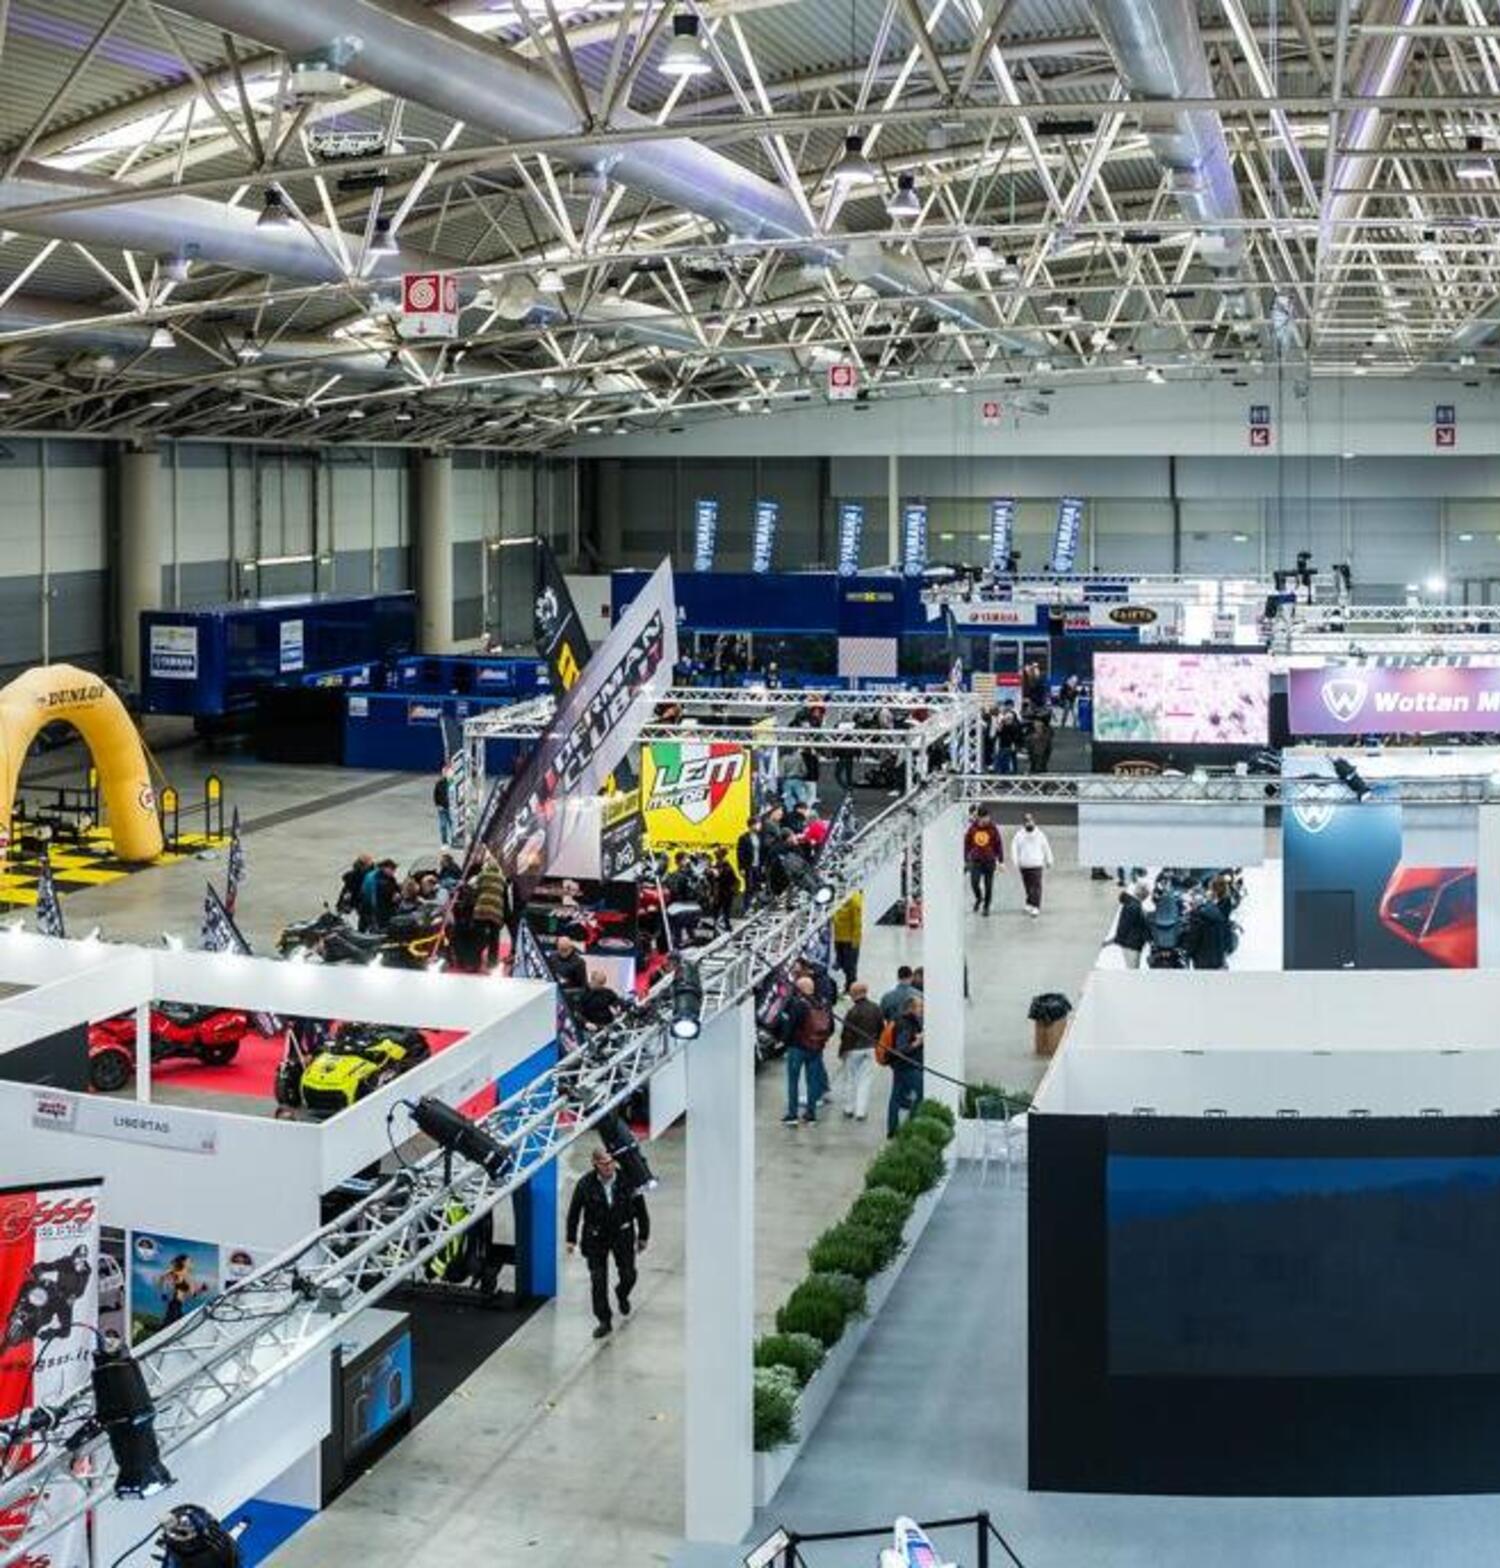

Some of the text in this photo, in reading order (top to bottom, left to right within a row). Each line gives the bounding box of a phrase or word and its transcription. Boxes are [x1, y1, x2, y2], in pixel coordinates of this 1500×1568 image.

[981, 612, 1019, 623] YAMAHA
[48, 685, 104, 706] DUNLOP
[1375, 691, 1469, 712] Wottan
[113, 1116, 171, 1133] LIBERTAS
